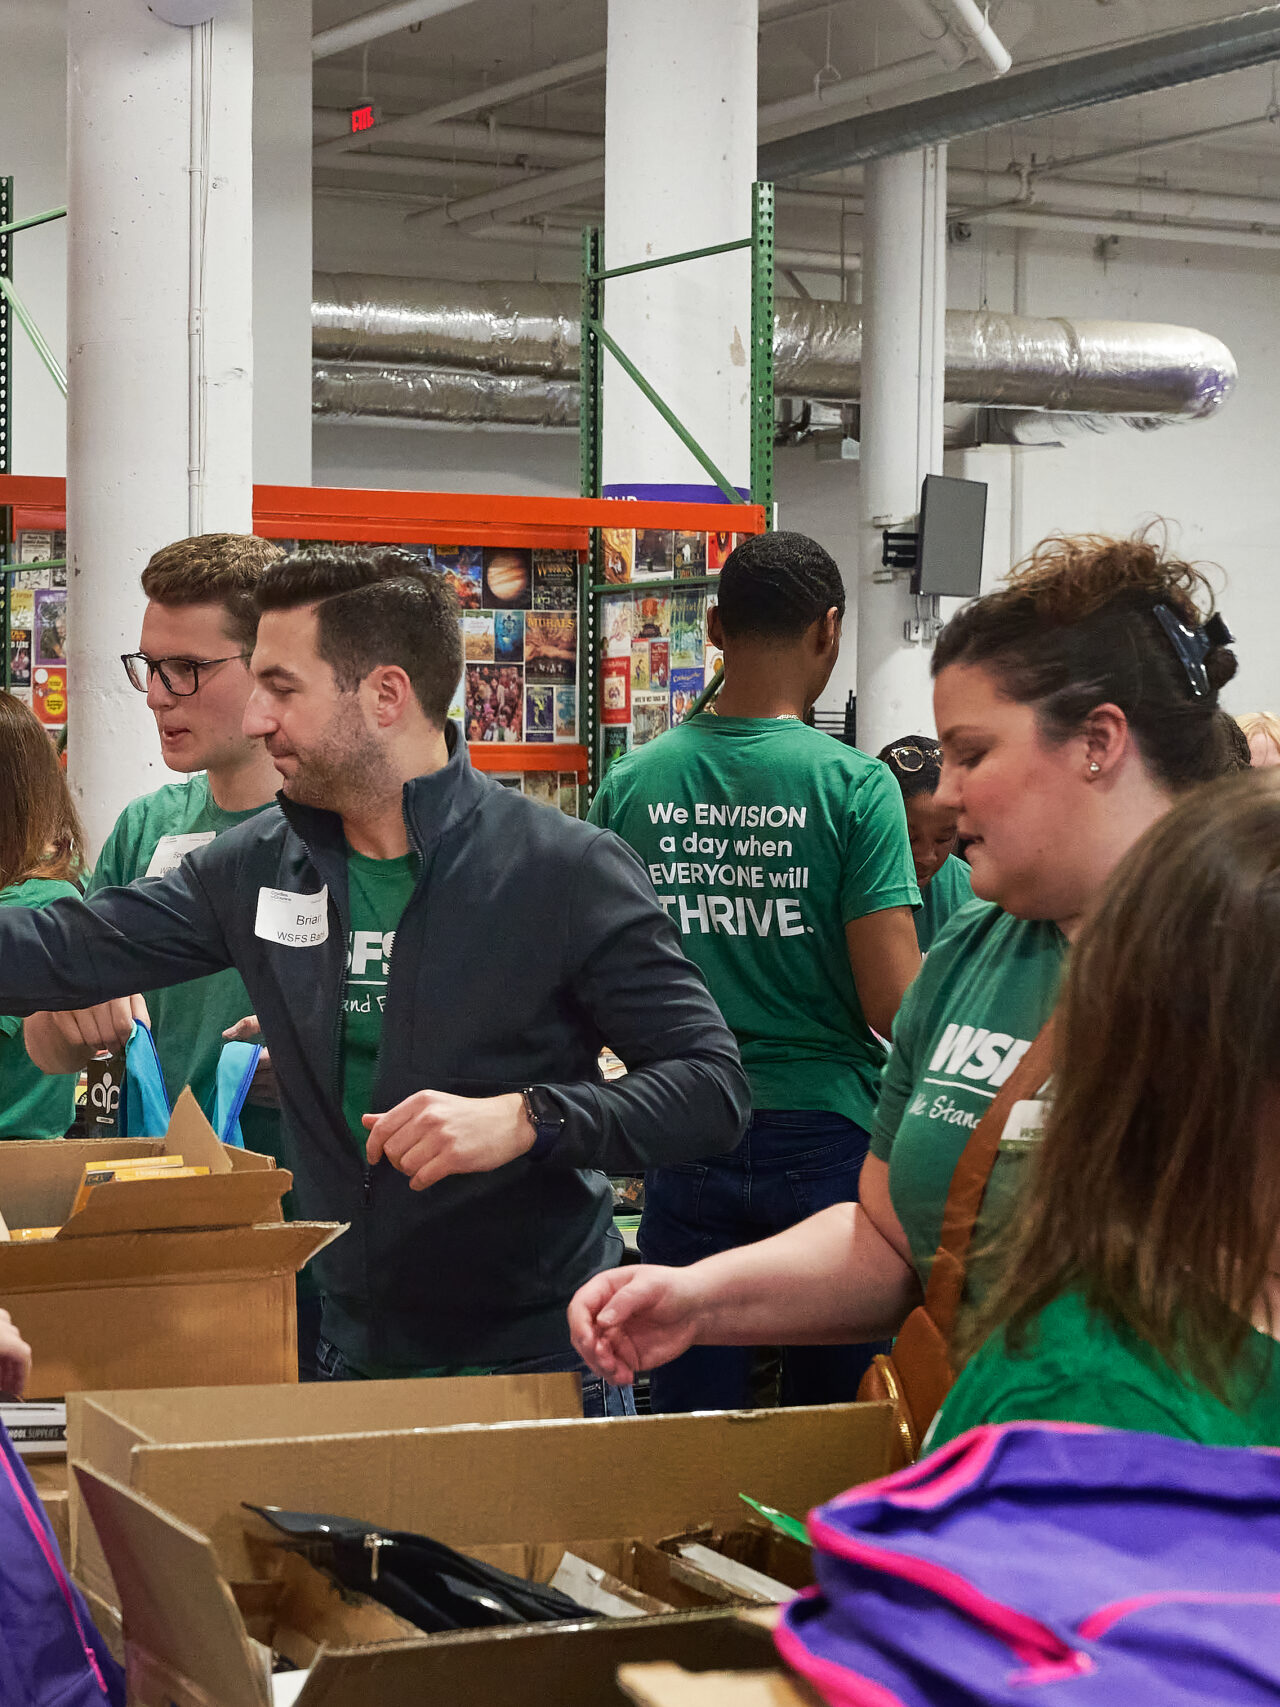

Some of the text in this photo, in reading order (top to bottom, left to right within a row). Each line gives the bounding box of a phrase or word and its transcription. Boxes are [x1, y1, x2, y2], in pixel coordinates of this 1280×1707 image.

[647, 802, 807, 828] We ENVISION
[659, 832, 792, 860] a day when
[648, 862, 809, 889] EVERYONE will
[657, 894, 814, 937] THRIVE.
[277, 931, 308, 943] WSFS
